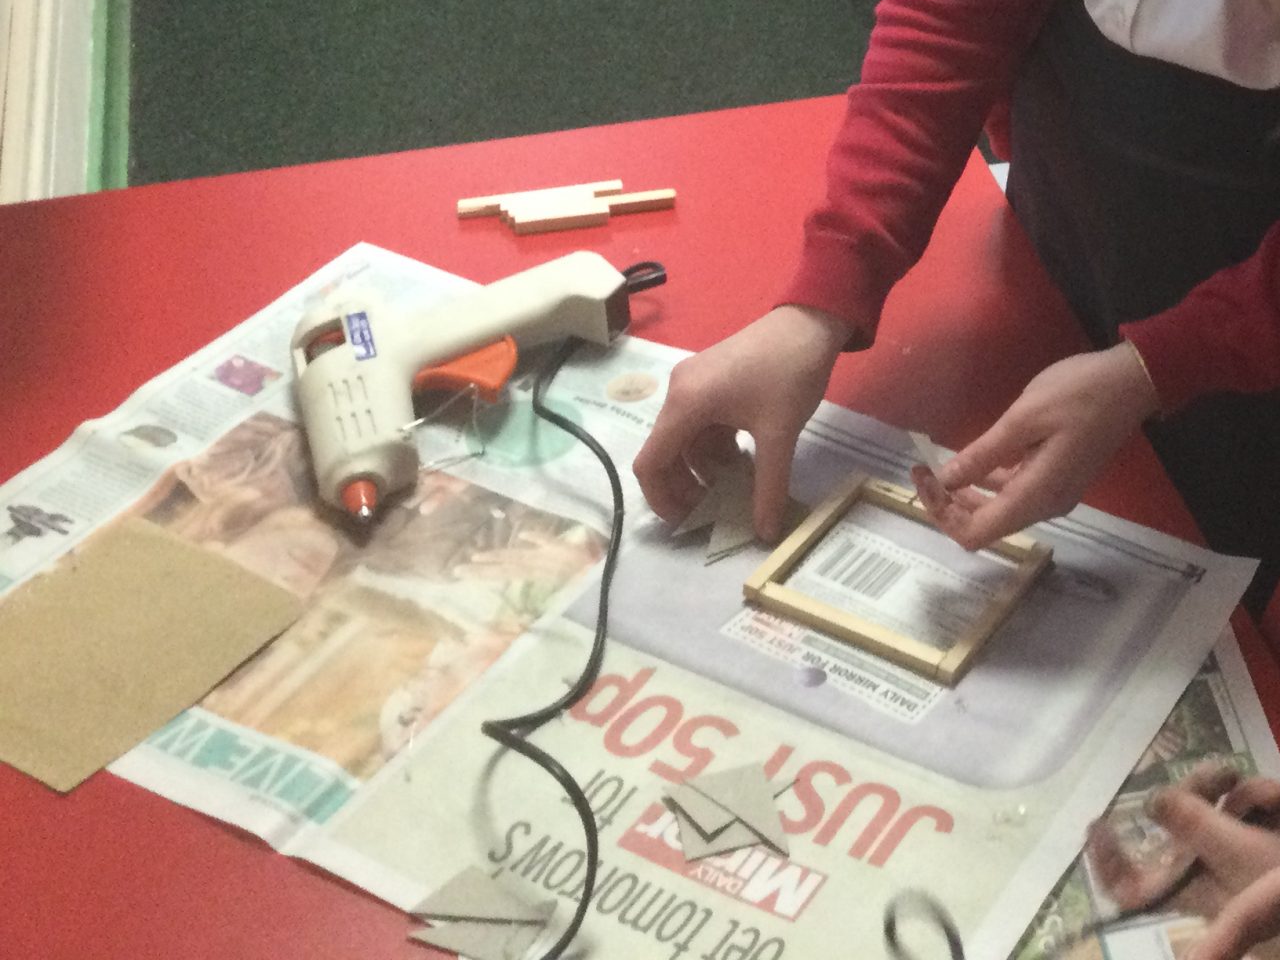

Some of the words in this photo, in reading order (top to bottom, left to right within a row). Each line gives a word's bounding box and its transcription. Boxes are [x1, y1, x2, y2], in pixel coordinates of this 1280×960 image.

[801, 650, 828, 669] FOR
[829, 662, 880, 692] MIRROR
[881, 689, 919, 713] DAILY
[568, 667, 740, 785] 50p
[209, 740, 335, 810] LIVE
[689, 864, 745, 891] DAILY
